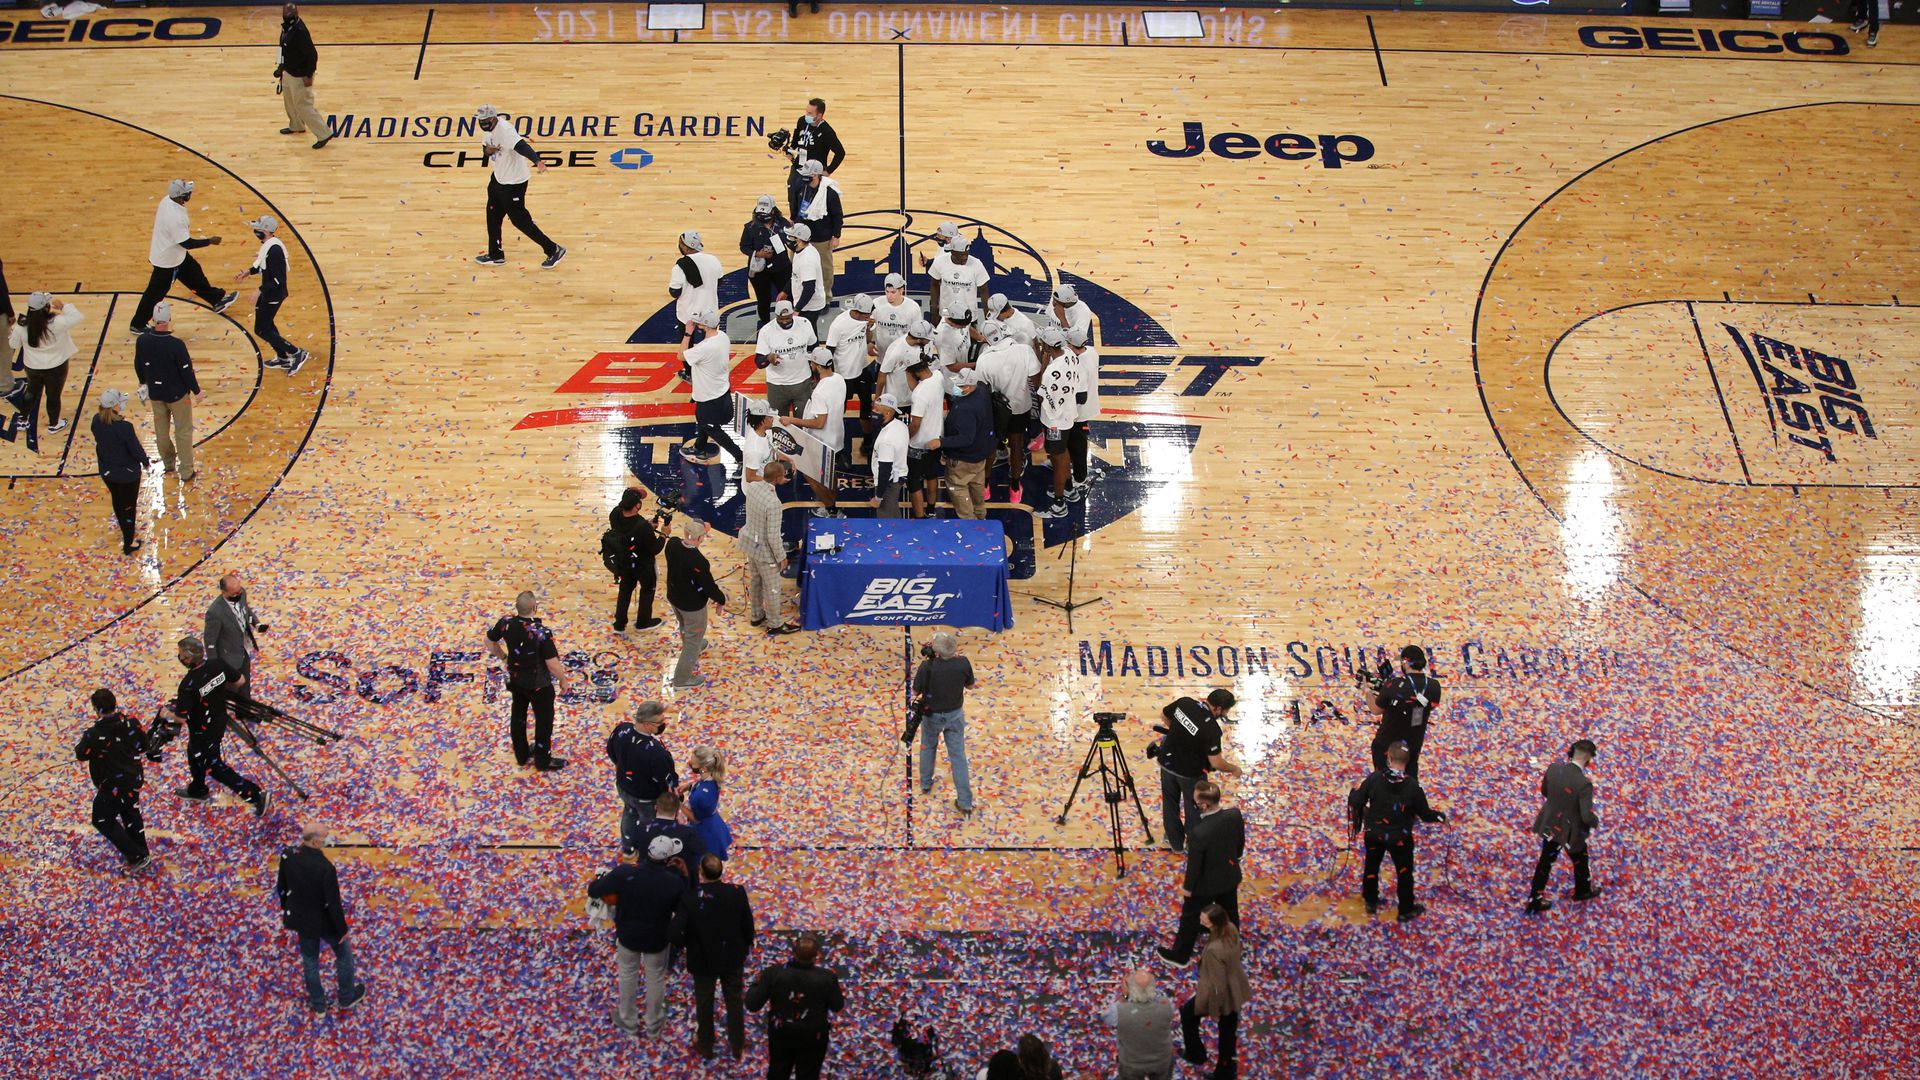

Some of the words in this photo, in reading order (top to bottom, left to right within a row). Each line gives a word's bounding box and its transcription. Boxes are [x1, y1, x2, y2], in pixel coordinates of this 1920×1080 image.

[1578, 26, 1850, 55] GEICO
[326, 114, 478, 138] MADISON
[633, 112, 765, 137] GARDEN
[1146, 122, 1375, 168] Jeep
[423, 151, 599, 168] CHSE
[1750, 332, 1837, 464] EAST
[1800, 346, 1878, 440] BIG
[864, 578, 937, 594] BIG
[853, 593, 955, 611] EAST
[873, 613, 946, 622] CONFERENCE
[1079, 640, 1270, 677] MADISON
